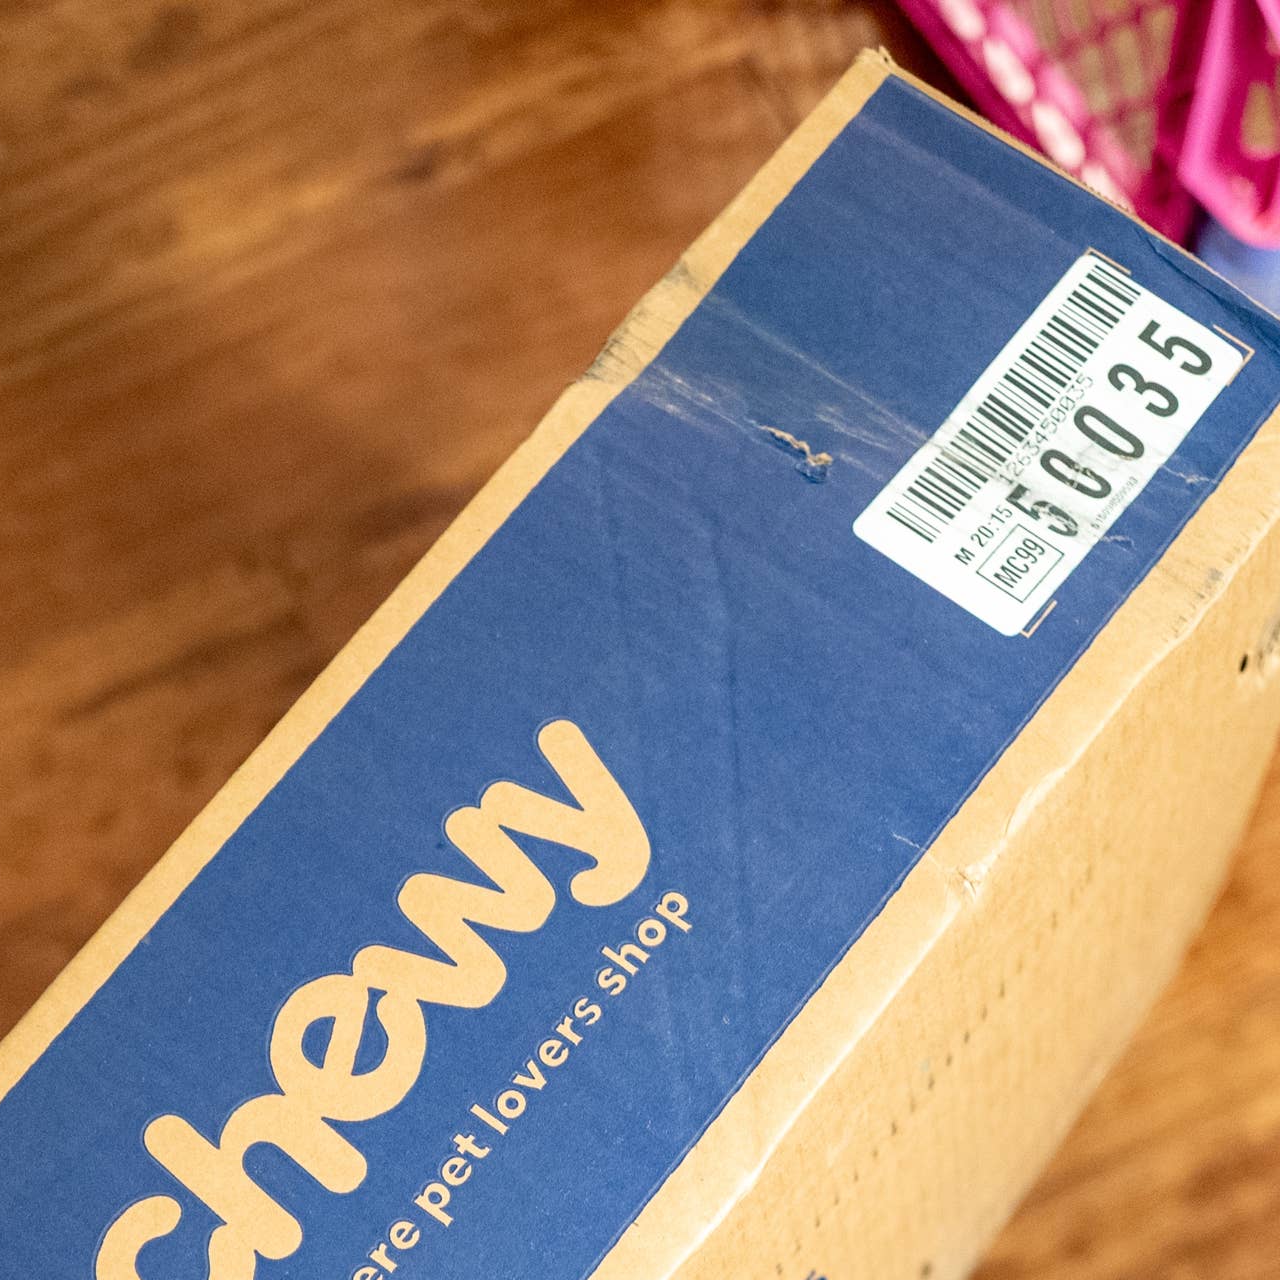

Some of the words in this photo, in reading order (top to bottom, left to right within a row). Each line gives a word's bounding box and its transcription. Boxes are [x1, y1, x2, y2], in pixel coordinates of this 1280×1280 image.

[1006, 319, 1213, 537] 50035
[953, 546, 976, 566] M
[970, 504, 1014, 548] 20:15
[993, 537, 1046, 589] MC99
[414, 1131, 491, 1227] pet
[470, 996, 602, 1135] lovers
[596, 889, 693, 994] shop
